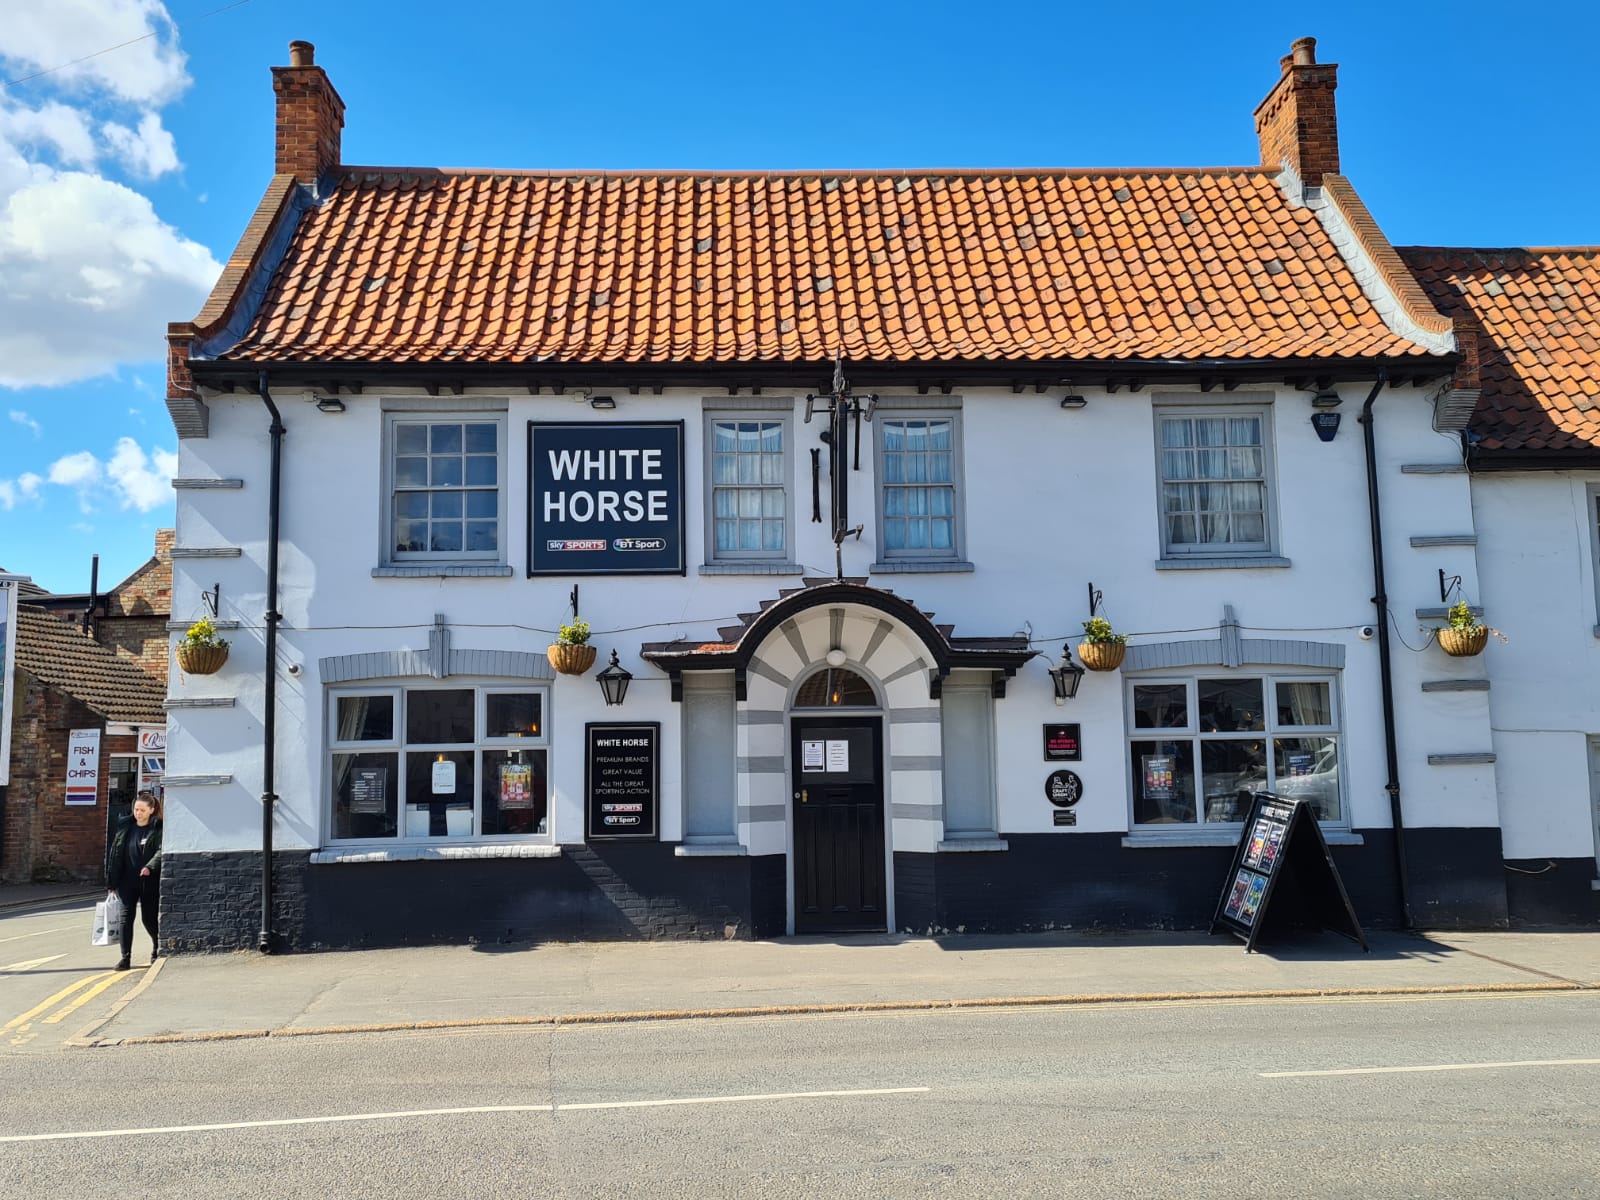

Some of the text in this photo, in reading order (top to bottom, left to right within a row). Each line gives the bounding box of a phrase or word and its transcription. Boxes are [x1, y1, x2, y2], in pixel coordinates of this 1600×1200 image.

[548, 450, 663, 480] WHITE
[544, 490, 668, 522] HORSE
[550, 540, 604, 550] sky SPORTS
[620, 540, 660, 549] BT Sport
[597, 739, 648, 747] WHITE HORSE
[73, 746, 94, 754] FISH
[80, 758, 86, 766] &
